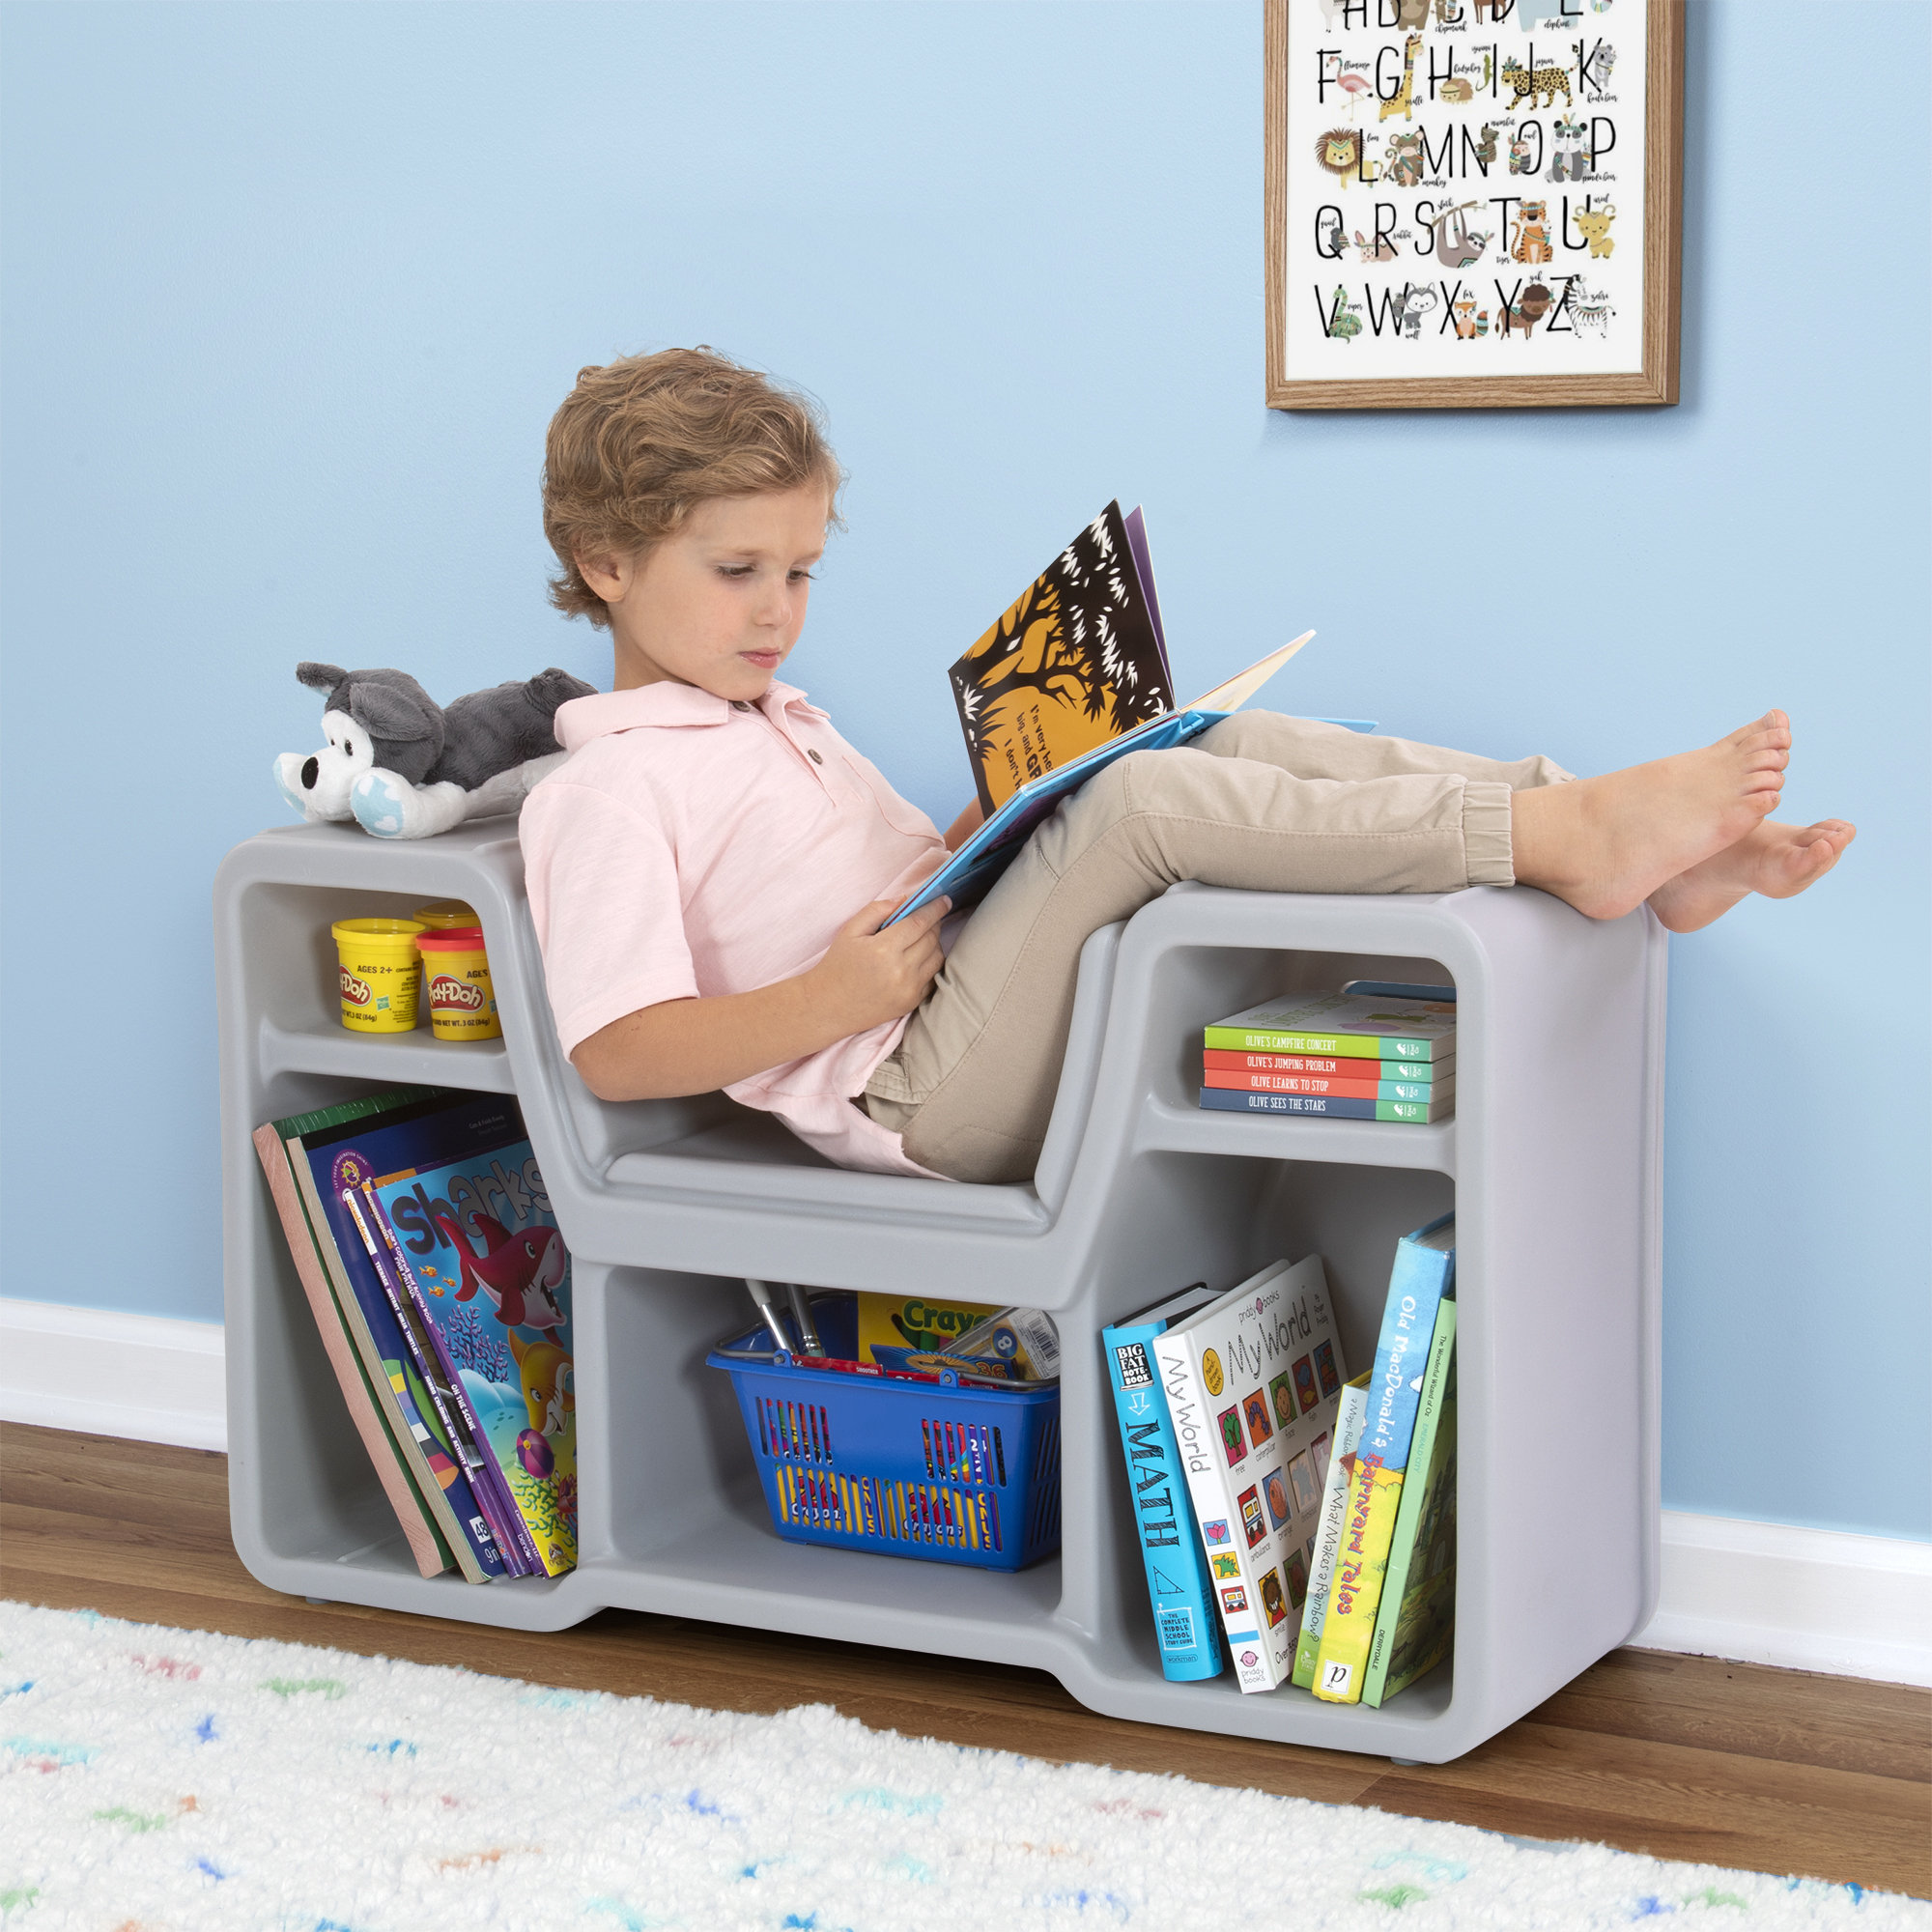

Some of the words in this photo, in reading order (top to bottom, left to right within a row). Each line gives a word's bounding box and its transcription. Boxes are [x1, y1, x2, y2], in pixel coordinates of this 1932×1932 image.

[1317, 48, 1342, 104] F
[1376, 46, 1400, 100] G
[1428, 45, 1453, 100] H
[1492, 43, 1497, 99] I
[1514, 42, 1533, 97] J
[1579, 37, 1603, 93] K
[1359, 128, 1378, 182] L
[1419, 124, 1453, 179] M
[1463, 122, 1489, 178] N
[1518, 120, 1543, 175] O
[1591, 117, 1616, 172] P
[1315, 205, 1343, 260] Q
[1375, 203, 1399, 257] R
[1414, 200, 1435, 255] S
[1489, 196, 1521, 252] T
[1563, 193, 1591, 250] U
[1314, 284, 1343, 338] V
[1364, 281, 1409, 336] W
[1439, 280, 1463, 335] X
[1493, 278, 1522, 333] Y
[1546, 276, 1574, 331] Z
[1463, 289, 1475, 299] fox
[1031, 704, 1039, 724] I'm
[1035, 724, 1046, 753] very
[1022, 734, 1033, 755] and
[1006, 748, 1019, 780] don't
[357, 965, 378, 974] AGES
[467, 969, 489, 979] AGES
[1245, 1035, 1271, 1048] OLIVE'S
[1272, 1037, 1305, 1050] CAMPFIRE
[1307, 1038, 1337, 1052] CONCERT
[1247, 1056, 1273, 1068] OLIVE'S
[1274, 1057, 1304, 1070] JUMPING
[1305, 1059, 1336, 1072] PROBLEM
[1251, 1075, 1271, 1088] OLIVE
[1272, 1077, 1298, 1090] LEARNS
[1300, 1079, 1310, 1091] TO
[1311, 1080, 1329, 1092] STOP
[1248, 1095, 1269, 1108] OLIVE
[1270, 1097, 1287, 1109] SEES
[1289, 1098, 1302, 1110] THE
[1304, 1099, 1326, 1112] STARS
[347, 1199, 369, 1244] nickelodeon
[375, 1261, 389, 1286] TEENAGE
[386, 1288, 400, 1311] MUTANT
[397, 1312, 408, 1330] NINJA
[406, 1329, 418, 1355] TURTLES
[1238, 1304, 1256, 1324] priddy
[1263, 1290, 1280, 1308] books
[1398, 1294, 1416, 1329] Old
[997, 1335, 1013, 1350] 8
[1117, 1344, 1143, 1359] BIG
[1228, 1333, 1261, 1385] My
[1259, 1295, 1312, 1360] World
[1437, 1335, 1447, 1347] The
[976, 1361, 1008, 1378] 36
[1120, 1354, 1146, 1371] FAT
[1122, 1366, 1148, 1378] NOTE-
[1431, 1348, 1444, 1378] Wonderful
[1124, 1373, 1150, 1385] BOOK
[1371, 1335, 1408, 1448] MacDonald's
[1426, 1378, 1439, 1401] Wizard
[450, 1383, 461, 1397] ON
[456, 1394, 468, 1410] THE
[462, 1407, 477, 1432] SCENE
[1162, 1355, 1189, 1401] My
[1176, 1404, 1211, 1473] World
[1345, 1404, 1358, 1430] Magic
[1424, 1406, 1434, 1418] Oz
[424, 1375, 437, 1395] JUMBO
[434, 1396, 448, 1425] COLORING
[446, 1426, 456, 1438] AND
[452, 1439, 468, 1469] ACTIVITY
[464, 1463, 475, 1484] BOOK
[1416, 1423, 1430, 1458] EMERALD
[1341, 1430, 1353, 1457] Ribbon
[1338, 1458, 1349, 1477] Book
[1413, 1458, 1422, 1474] CITY
[1125, 1419, 1179, 1548] MATH
[1326, 1487, 1345, 1525] What
[1348, 1451, 1384, 1556] Barnyard
[475, 1521, 489, 1538] 48
[517, 1533, 533, 1562] bendon
[1318, 1526, 1337, 1572] Makes
[1319, 1572, 1327, 1580] a
[1337, 1560, 1363, 1616] Tales
[1161, 1617, 1190, 1626] COMPLETE
[1308, 1581, 1328, 1642] Rainbow?
[1275, 1648, 1289, 1664] Over
[1371, 1629, 1386, 1670] DERRYDALE
[1241, 1668, 1264, 1678] priddy
[1243, 1675, 1266, 1685] books
